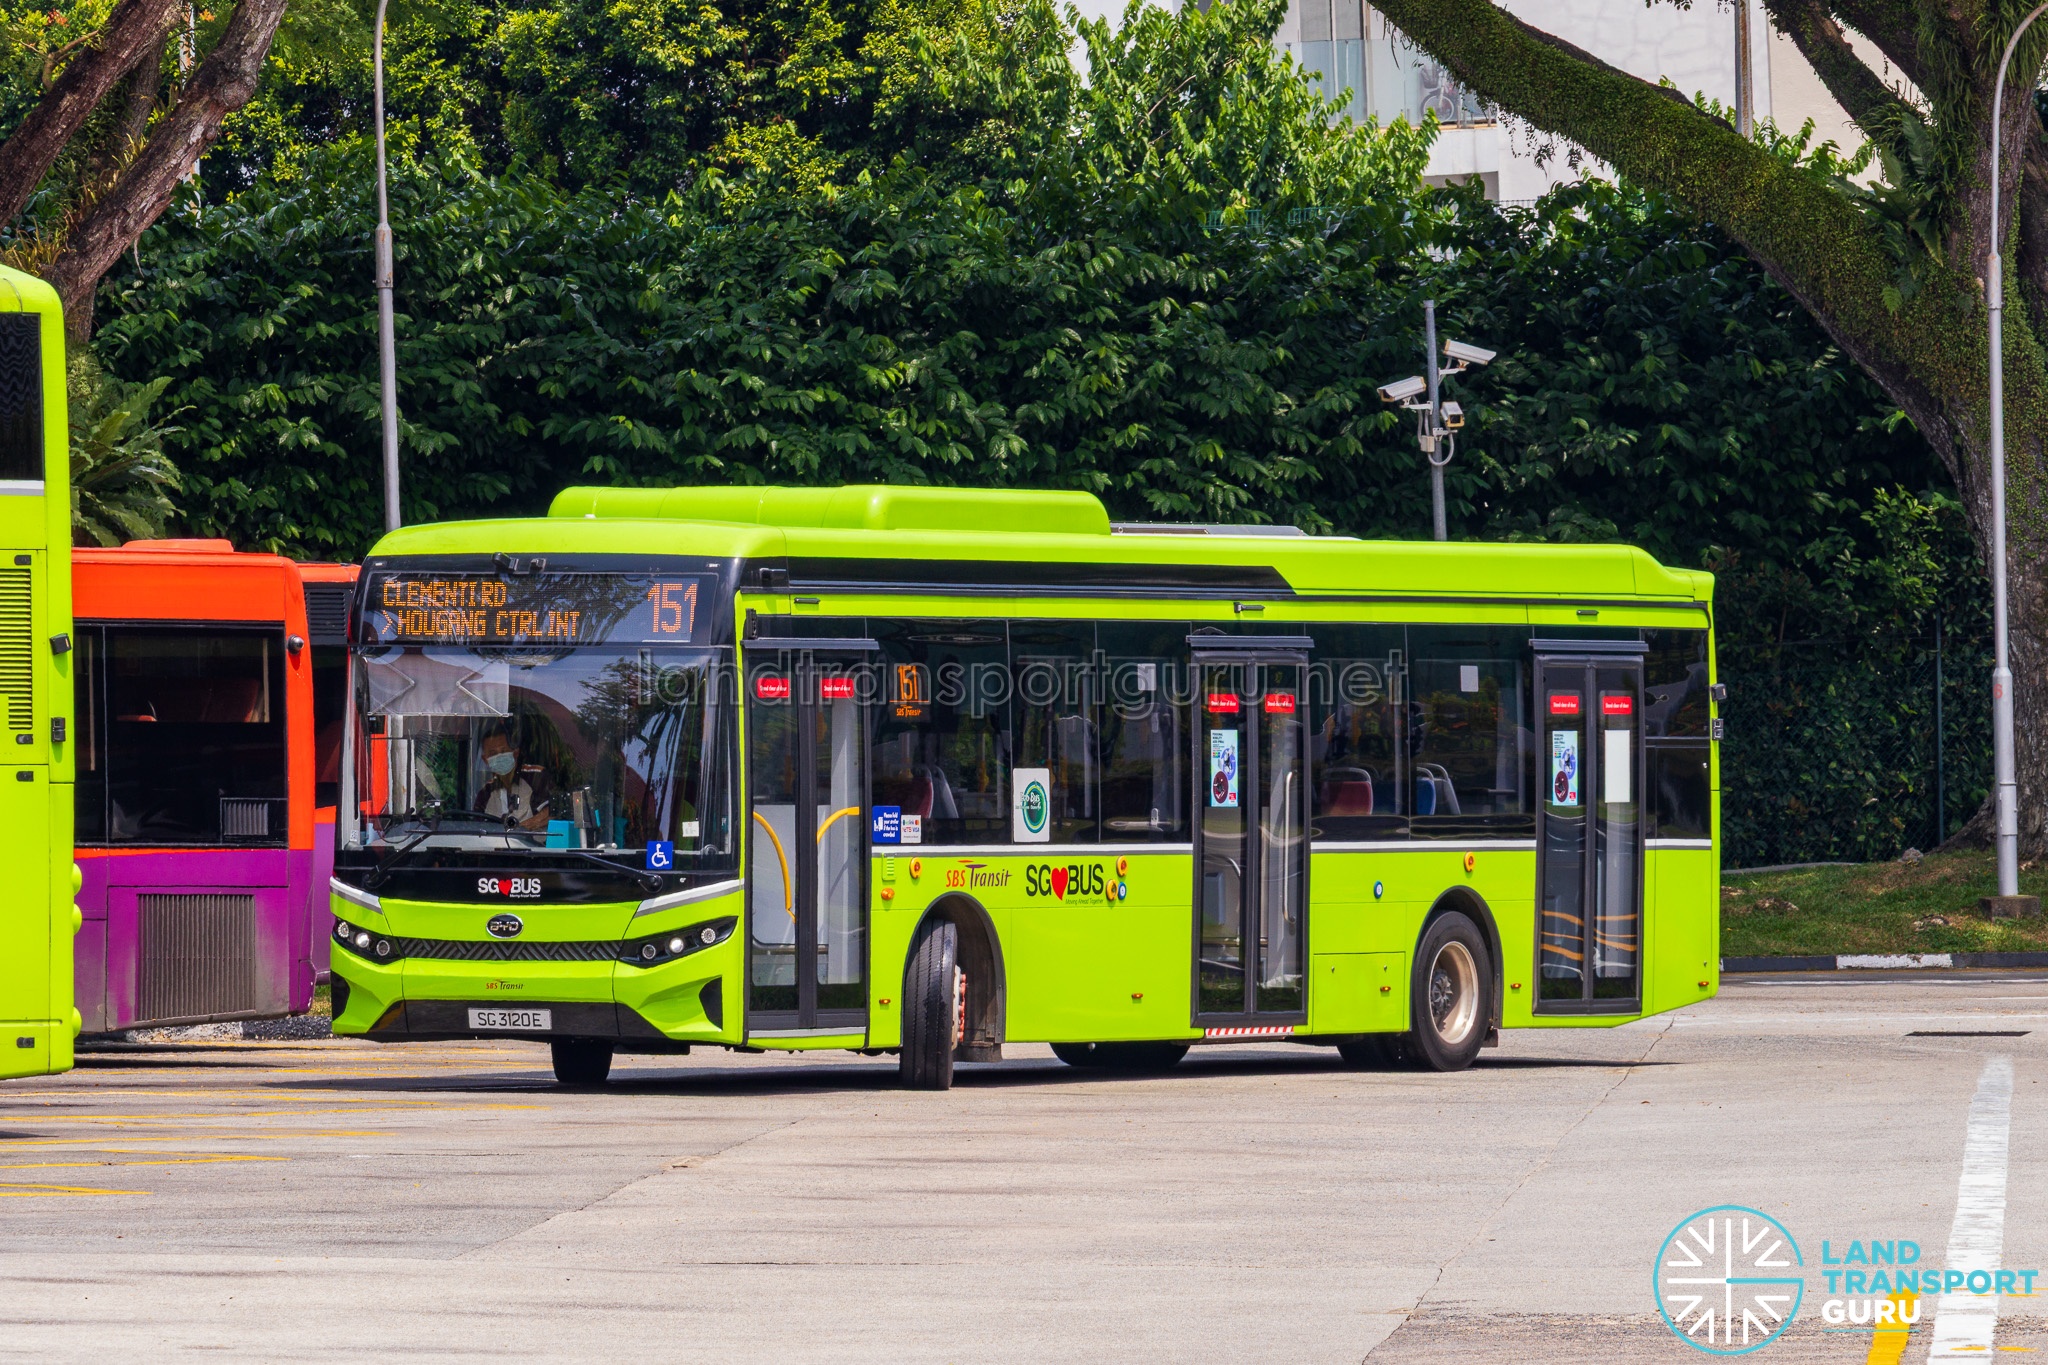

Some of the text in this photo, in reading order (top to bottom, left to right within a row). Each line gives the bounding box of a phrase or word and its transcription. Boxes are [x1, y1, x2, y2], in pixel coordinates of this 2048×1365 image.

[383, 581, 507, 607] CLEMENTI RD
[647, 583, 698, 633] 151
[397, 610, 580, 637] HOUGANG CTRL INT
[897, 665, 918, 700] 151
[946, 864, 1012, 890] SBS Transit
[489, 921, 519, 932] BYD
[486, 980, 524, 991] SBS Transit
